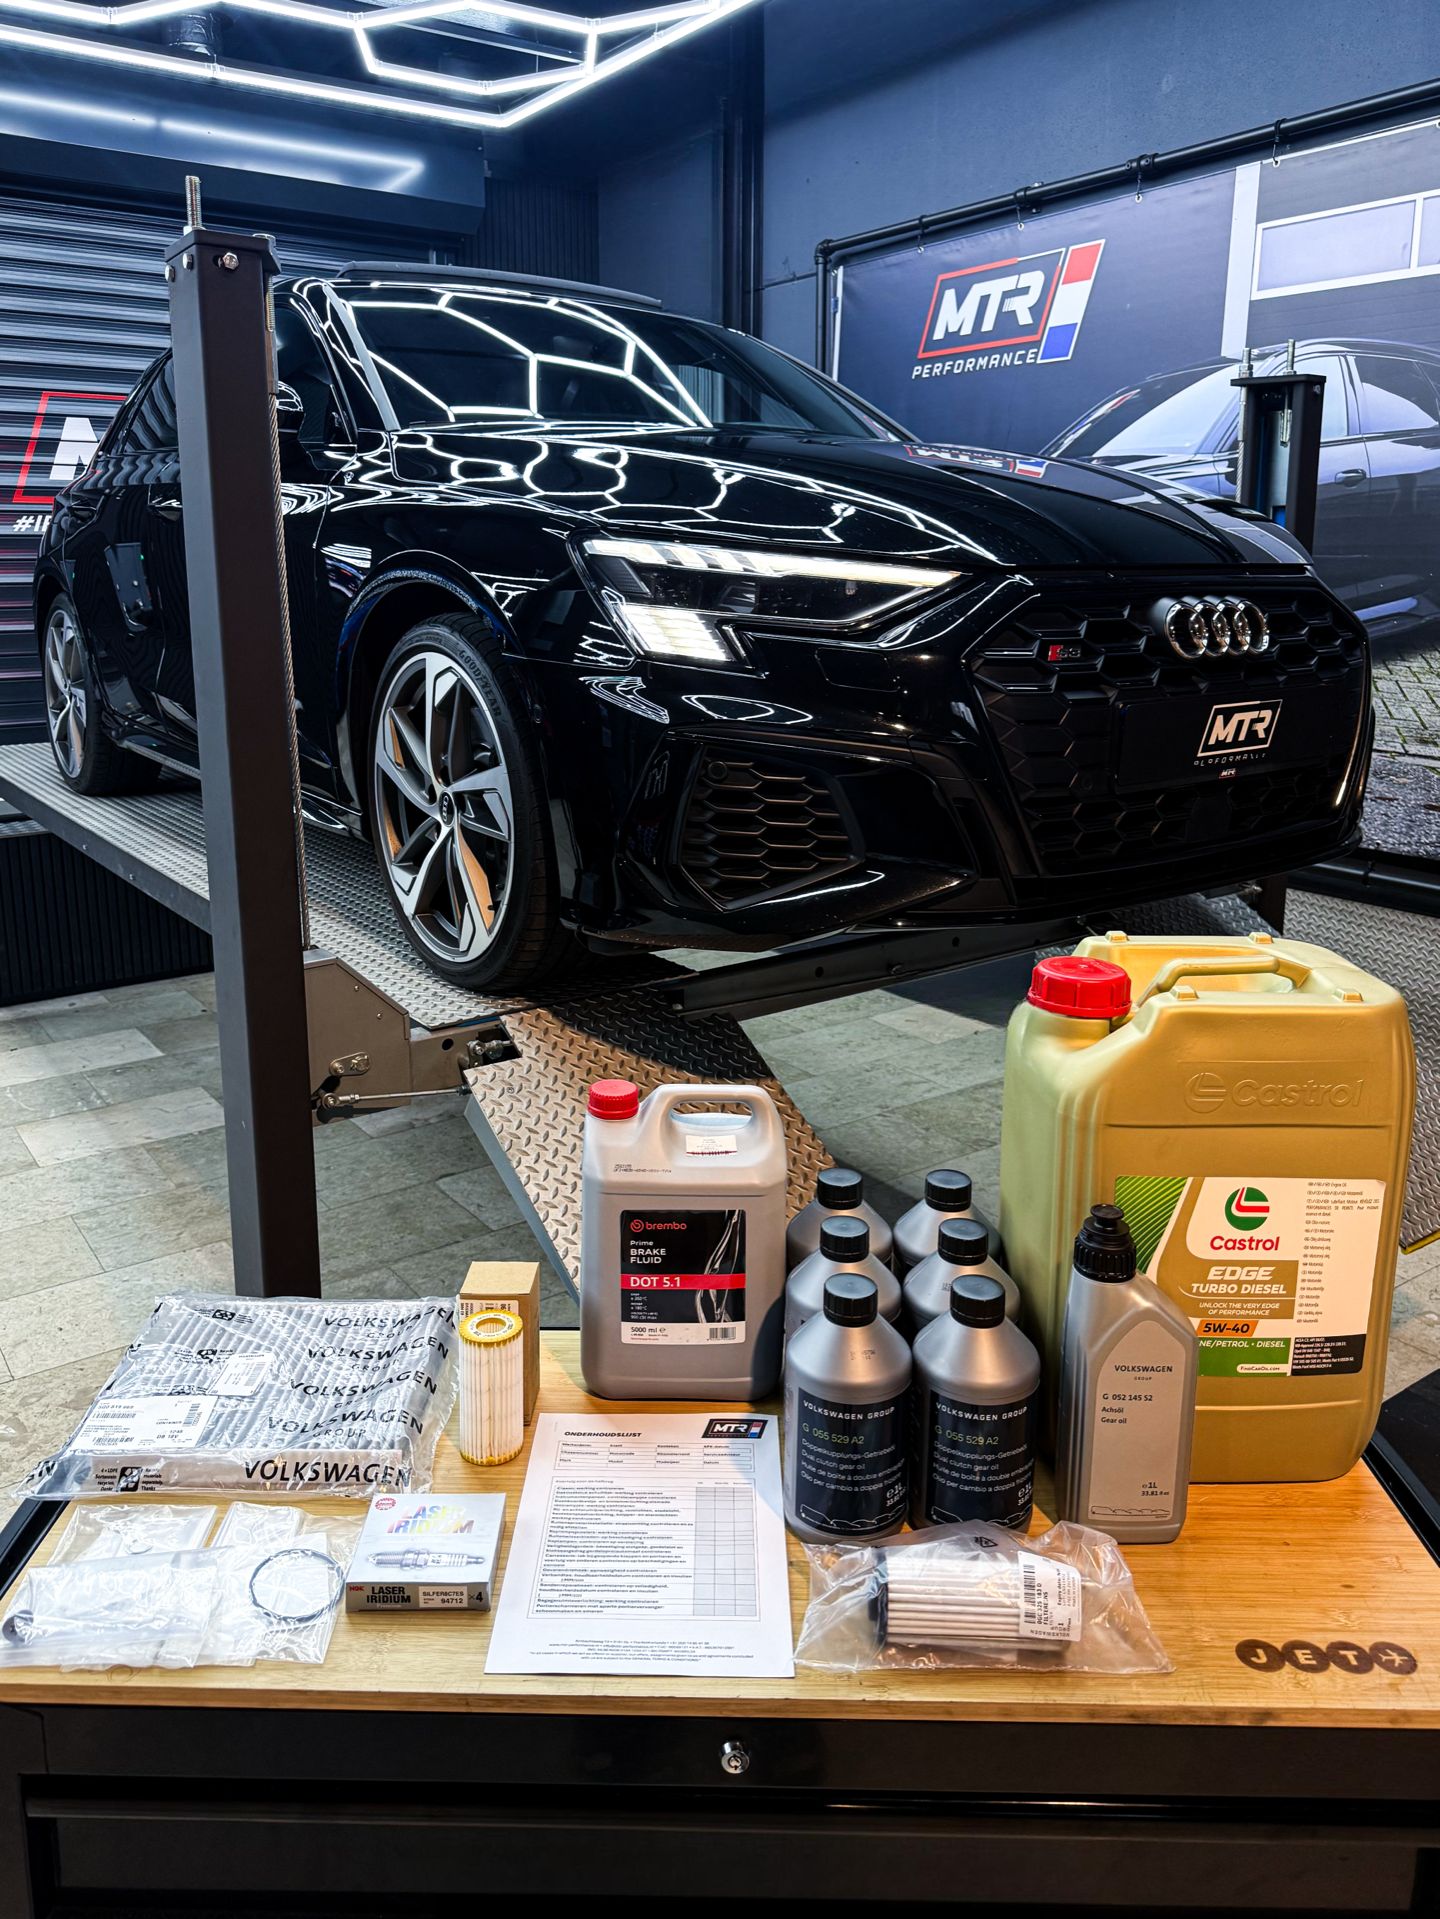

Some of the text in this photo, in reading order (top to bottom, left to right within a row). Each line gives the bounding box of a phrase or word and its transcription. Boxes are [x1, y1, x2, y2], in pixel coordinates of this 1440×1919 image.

[932, 270, 1045, 340] MTR
[912, 348, 1039, 379] PERFORMANCE
[459, 649, 502, 717] GOODYEAR
[1208, 709, 1273, 745] MTR
[1231, 1078, 1365, 1108] Castrol
[645, 1221, 688, 1231] brembo
[1209, 1235, 1280, 1251] Castrol
[630, 1248, 667, 1256] BRAKE
[1207, 1266, 1276, 1281] EDGE
[630, 1276, 681, 1287] DOT 5.1
[1191, 1283, 1287, 1294] TURBO DIESEL
[1202, 1322, 1250, 1334] 5W-40
[308, 1336, 449, 1359] VOLKSWAGEN
[1199, 1339, 1286, 1348] NE/PETROL DIESEL
[1114, 1364, 1173, 1373] VOLKSWAGEN
[290, 1370, 438, 1395] VOLKSWAGEN
[803, 1400, 895, 1420] VOLKSWAGEN GROUP
[935, 1402, 1028, 1421] VOLKSWAGEN GROUP
[1101, 1406, 1124, 1414] Achsöl
[268, 1409, 424, 1435] VOLKSWAGEN
[1101, 1416, 1117, 1424] Gear
[713, 1423, 748, 1433] MTR
[802, 1423, 865, 1445] G 055 529 A2
[945, 1429, 964, 1442] 055
[966, 1435, 985, 1445] 529
[986, 1436, 999, 1445] A2
[838, 1463, 855, 1471] gear
[949, 1458, 972, 1469] clutch
[973, 1464, 989, 1472] gear
[244, 1459, 412, 1487] VOLKSWAGEN
[852, 1472, 877, 1481] double
[987, 1473, 1010, 1481] double
[825, 1482, 853, 1492] cambio
[946, 1479, 958, 1488] per
[959, 1484, 987, 1492] cambio
[371, 1586, 405, 1595] LASER
[366, 1595, 411, 1604] IRIDIUM
